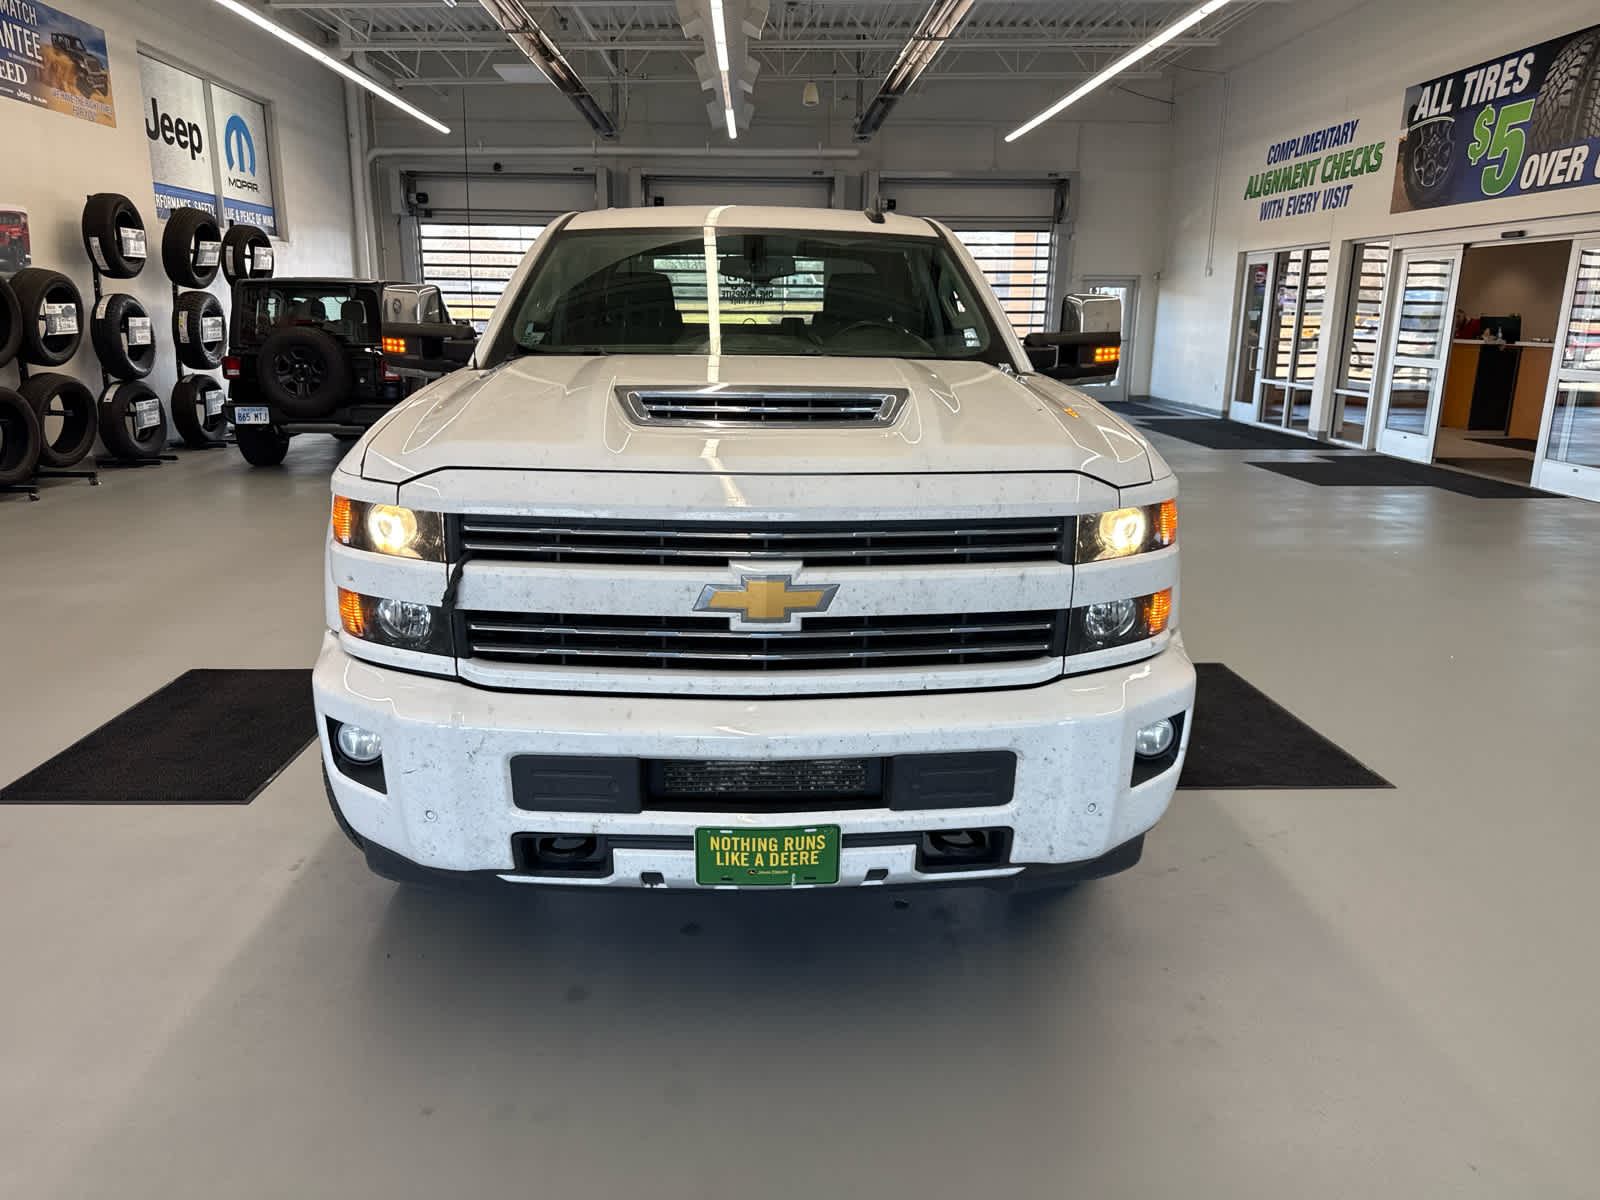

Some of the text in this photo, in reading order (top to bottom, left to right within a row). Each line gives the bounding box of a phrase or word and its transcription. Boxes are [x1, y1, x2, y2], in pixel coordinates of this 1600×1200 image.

[0, 0, 37, 26] MATCH
[1413, 52, 1535, 121] ALL TIRES
[145, 98, 203, 160] Jeep
[1266, 119, 1360, 165] COMPLIMENTARY
[1467, 98, 1536, 196] $5
[228, 177, 259, 193] MOPAR
[1244, 141, 1386, 200] ALIGNMENT CHECKS
[1519, 144, 1590, 190] OVER
[1259, 184, 1354, 222] WITH EVERY VISIT
[709, 834, 826, 852] NOTHING RUNS
[715, 850, 820, 867] LIKE A DEERE
